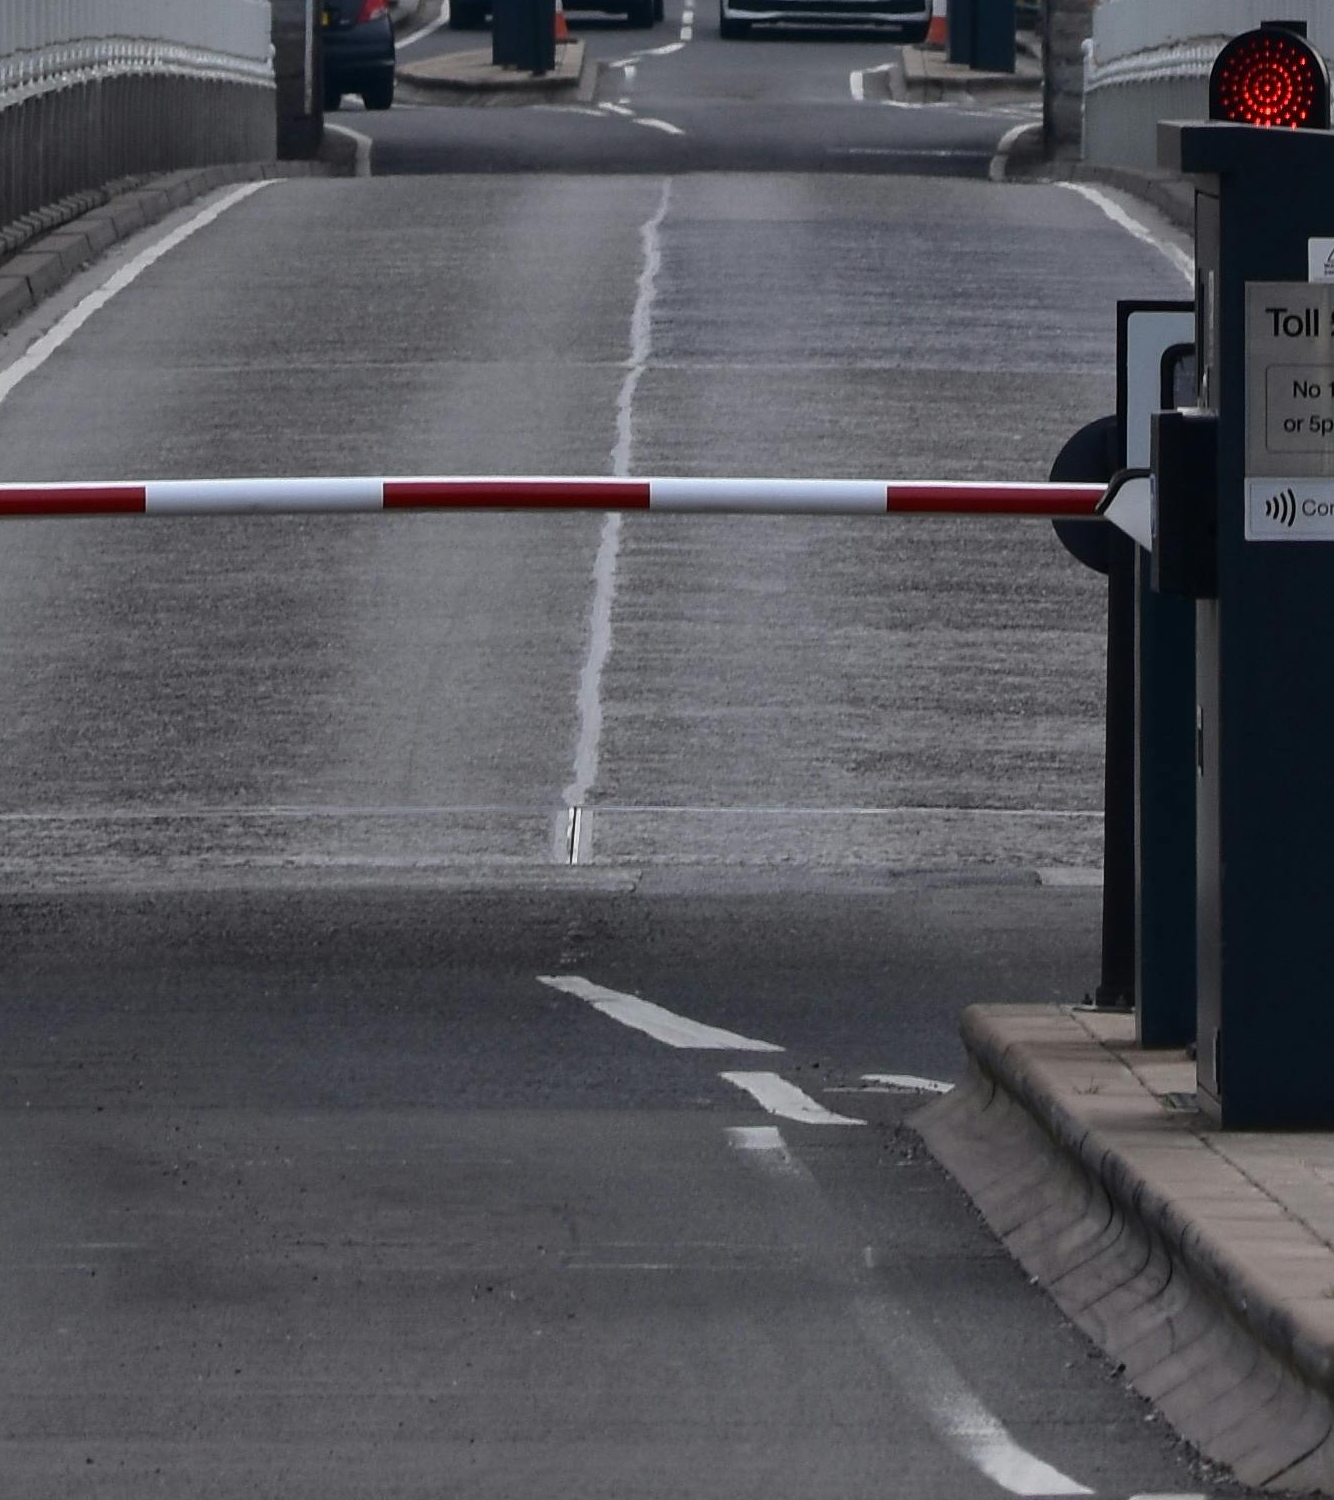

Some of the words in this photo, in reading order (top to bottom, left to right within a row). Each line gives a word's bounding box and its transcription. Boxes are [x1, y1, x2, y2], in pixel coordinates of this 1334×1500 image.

[1265, 308, 1319, 338] Toll
[1293, 381, 1321, 399] No
[1283, 419, 1304, 433] or
[1309, 415, 1334, 438] 5p
